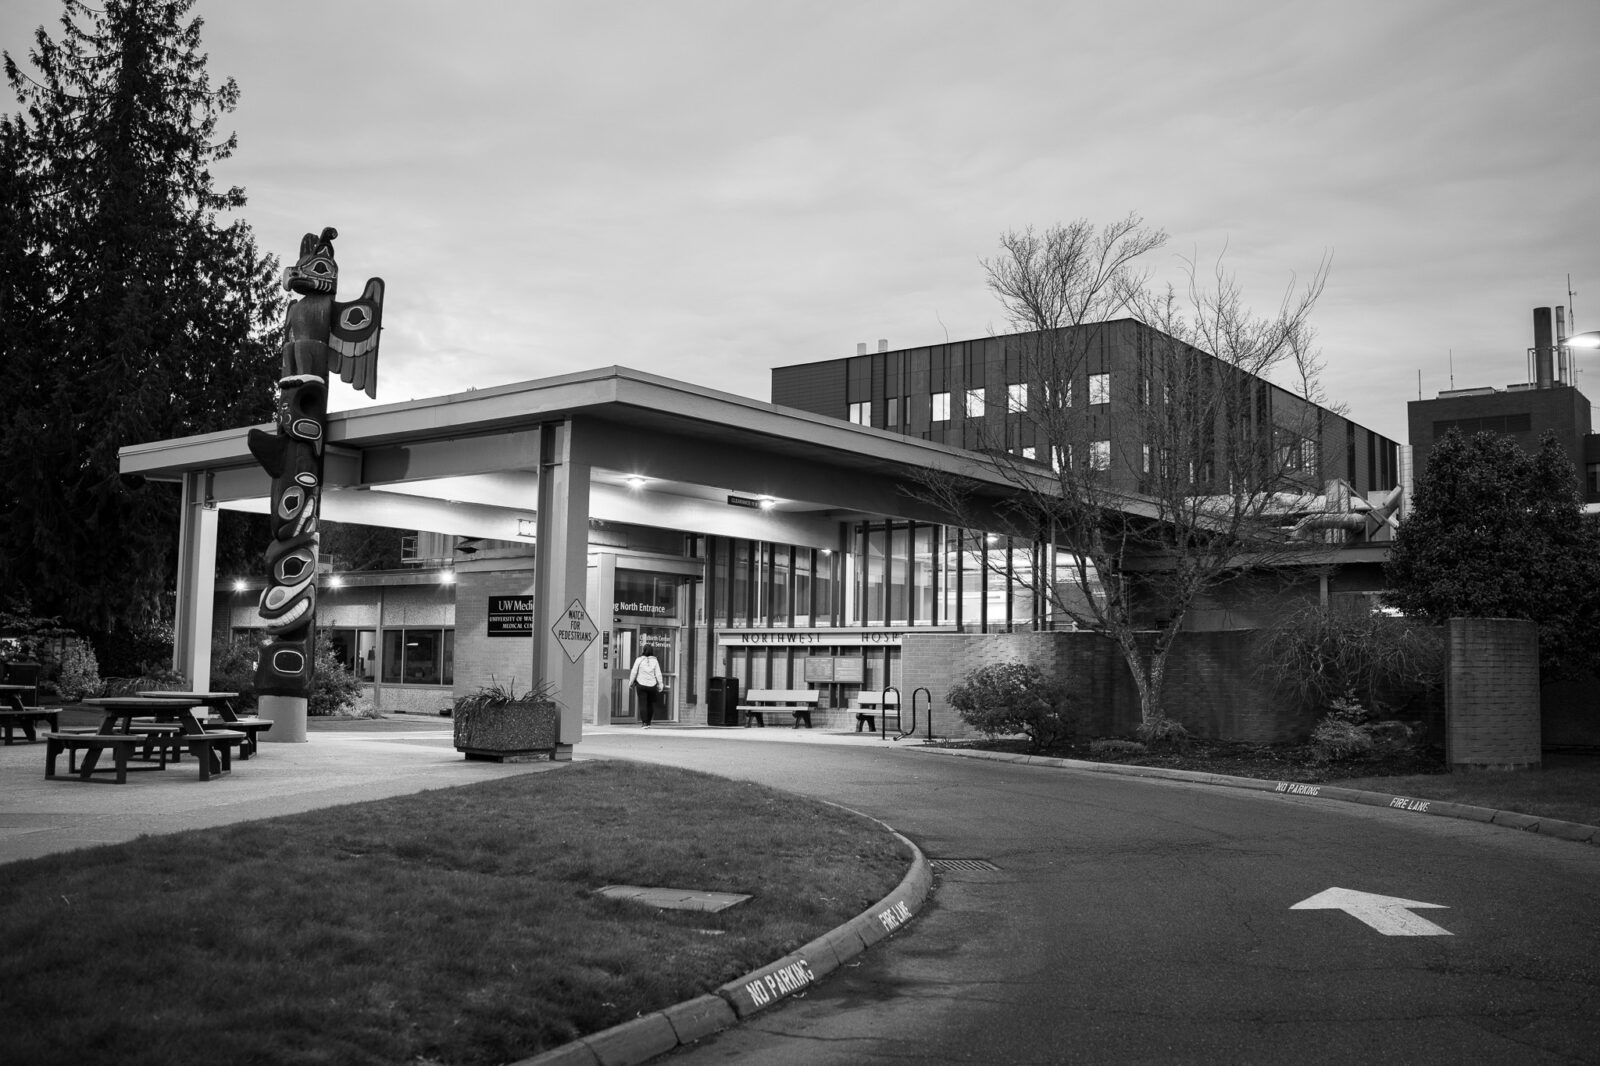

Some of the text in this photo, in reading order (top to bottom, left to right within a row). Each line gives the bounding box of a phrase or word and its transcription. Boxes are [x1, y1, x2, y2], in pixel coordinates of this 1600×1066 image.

[498, 600, 513, 611] UW
[620, 601, 638, 611] North
[639, 602, 666, 613] Entrance
[568, 610, 585, 620] WATCH
[570, 620, 581, 630] FOR
[558, 629, 592, 641] PEDESTRIANS
[741, 631, 899, 644] NORTHWEST HOSP
[1275, 782, 1321, 796] NO PARKING
[1389, 797, 1431, 813] FIRE LANE
[878, 900, 912, 932] FIRE LANE
[745, 959, 815, 1007] NO PARKING
